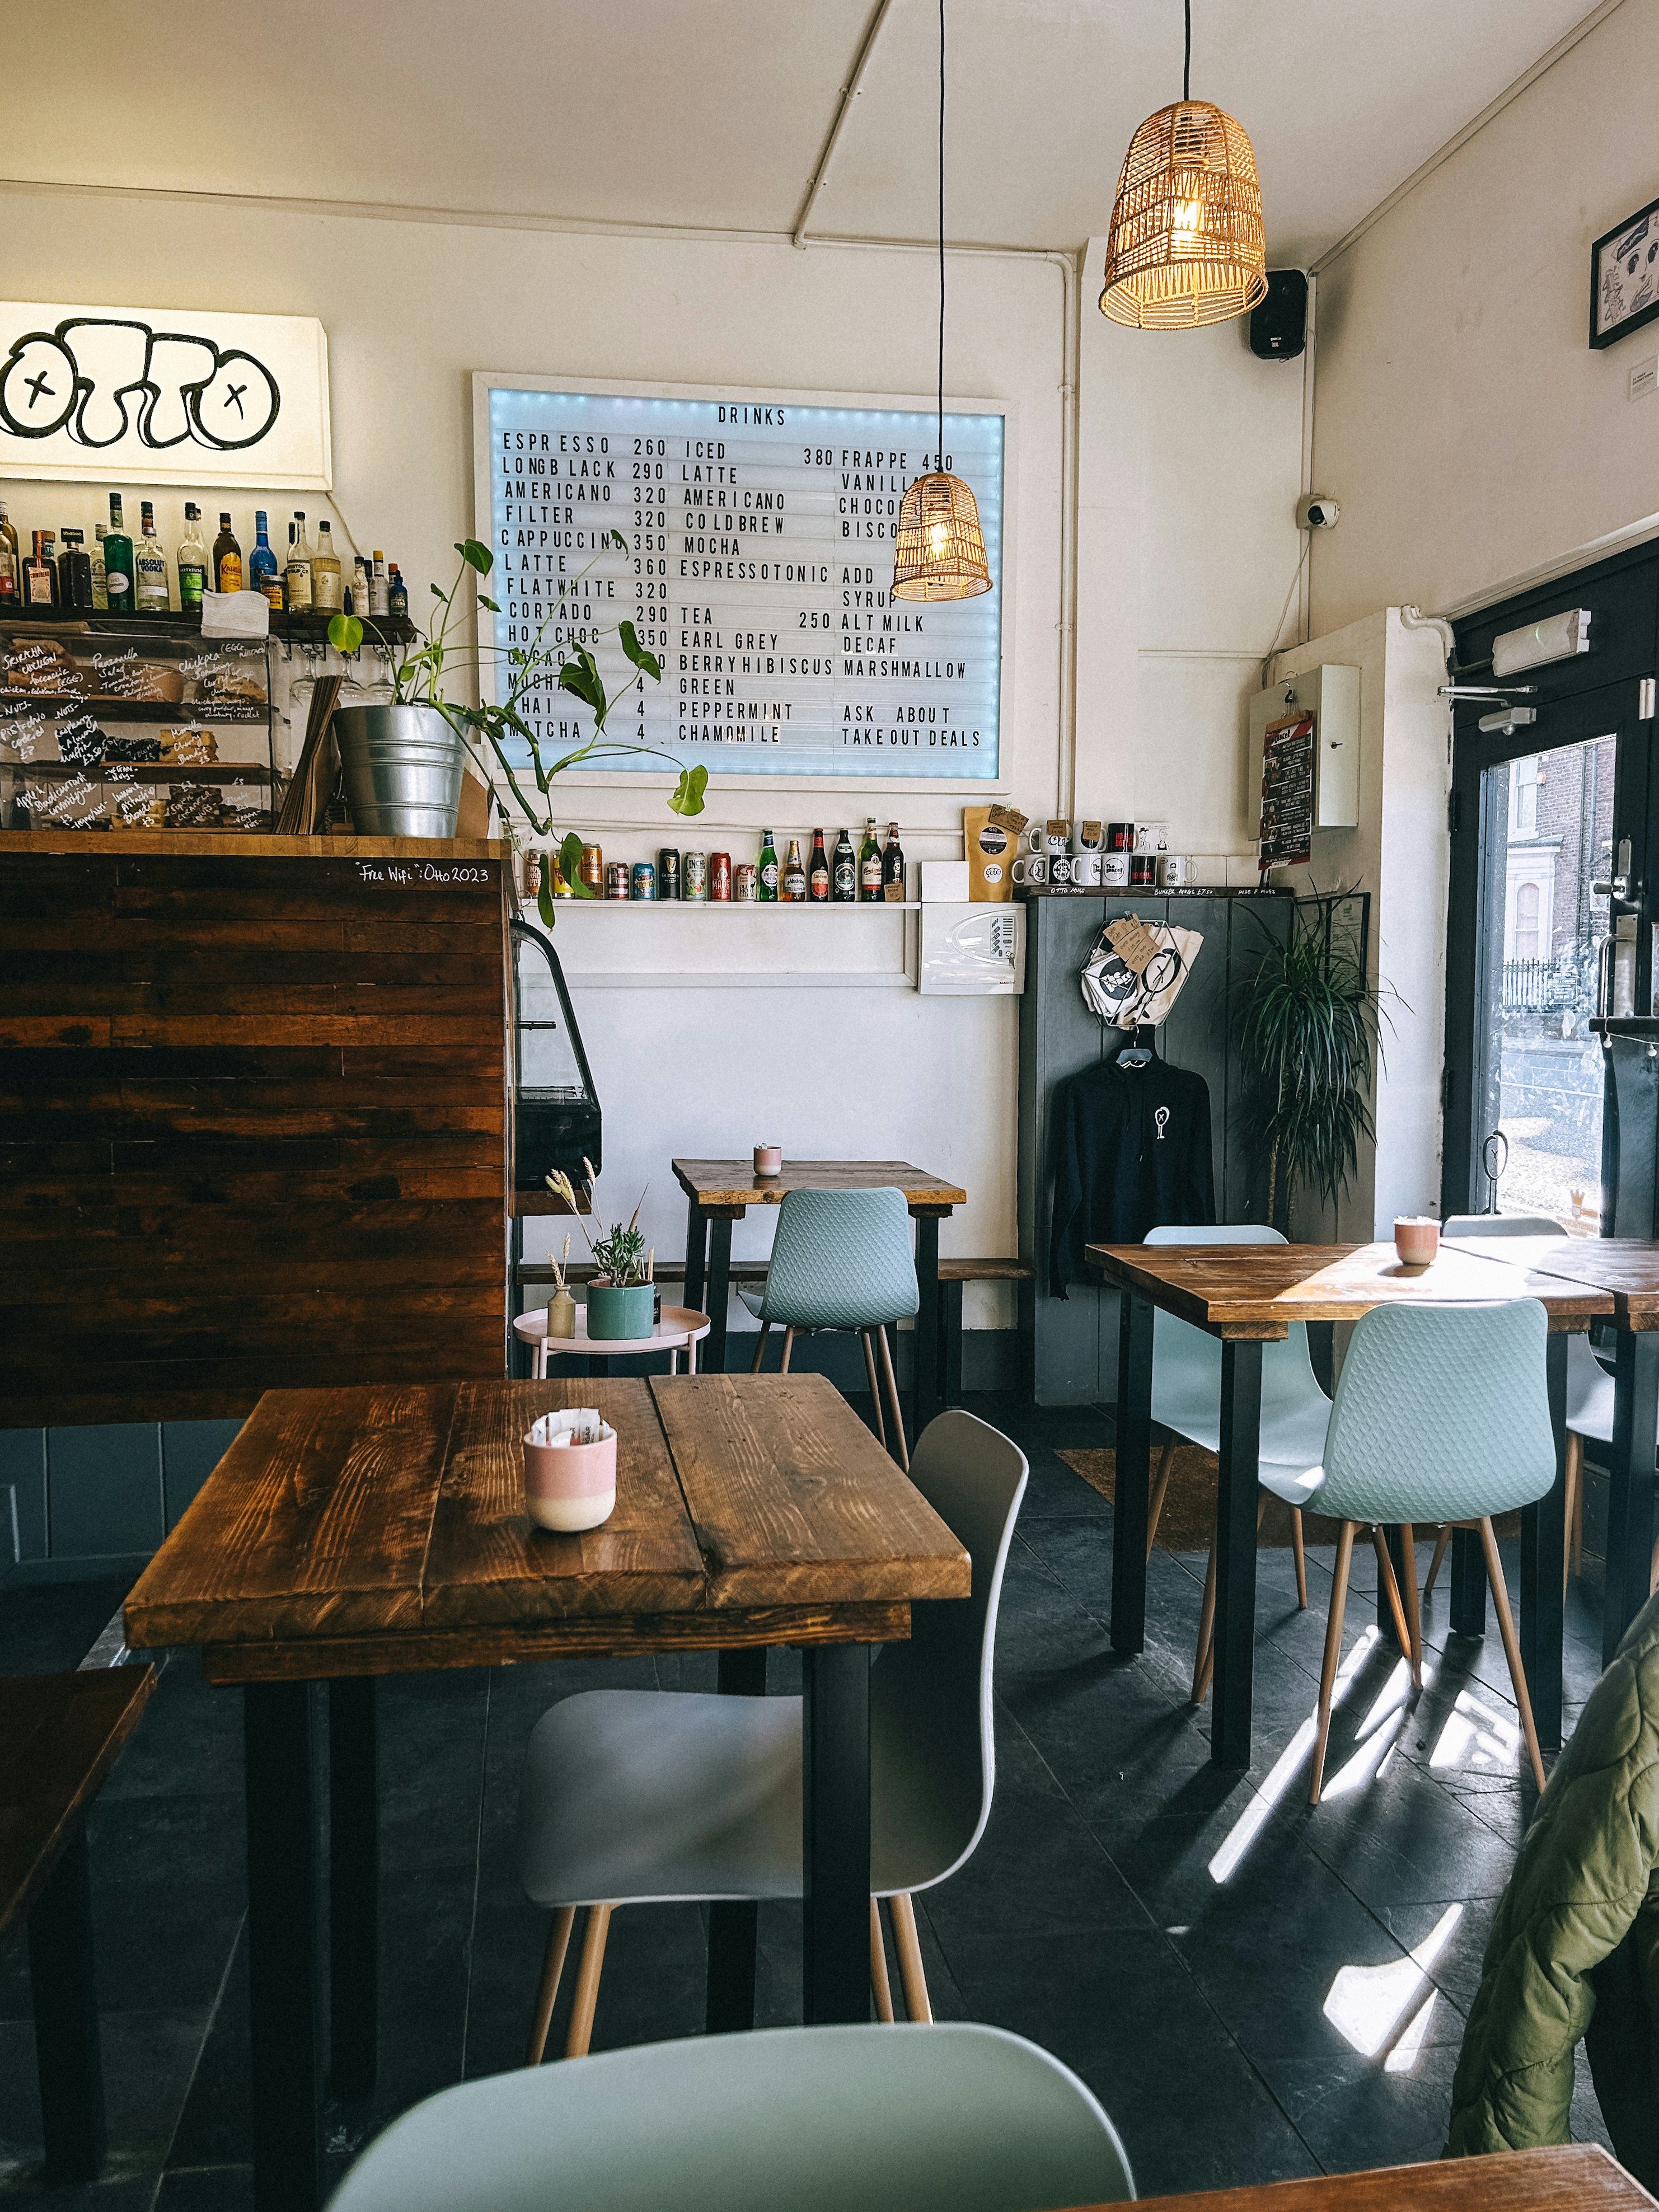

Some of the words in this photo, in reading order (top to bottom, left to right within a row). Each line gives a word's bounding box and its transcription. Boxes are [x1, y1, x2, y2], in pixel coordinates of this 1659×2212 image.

[0, 317, 280, 451] OTTO
[719, 407, 784, 425] DRINKS
[504, 433, 608, 453] ESPRESSO
[634, 439, 664, 456] 260
[687, 441, 724, 459] ICED
[804, 448, 832, 465] 380
[843, 450, 906, 468] FRAPPE
[922, 454, 952, 471] 450
[633, 463, 662, 479] 290
[683, 465, 736, 484] LATTE
[842, 474, 918, 492] VANILL
[505, 481, 610, 501] AMERICANO
[634, 487, 665, 504] 320
[684, 489, 784, 510] AMERICANO
[840, 498, 902, 515] CHOCO
[507, 505, 573, 523] FILTER
[635, 510, 664, 527] 320
[502, 529, 622, 549] CAPPUCCINO
[634, 534, 664, 551] 350
[685, 537, 739, 555] MOCHA
[139, 559, 165, 567] ABSOLUT
[140, 564, 163, 573] VODKA
[505, 554, 565, 571] LATTE
[634, 558, 665, 575] 360
[843, 568, 872, 583] ADD
[508, 578, 614, 597] FLATWHITE
[636, 582, 666, 599] 320
[843, 591, 896, 608] SYRUP
[510, 602, 591, 620] CORTADO
[637, 606, 667, 622] 290
[681, 607, 711, 624] TEA
[799, 612, 829, 628] 250
[842, 613, 873, 630] ALT
[883, 615, 922, 631] MILK
[509, 625, 543, 641] HOT
[555, 627, 598, 644] CHOC
[638, 630, 667, 646] 350
[682, 631, 723, 648] EARL
[736, 633, 777, 650] GREY
[844, 636, 896, 653] DECAF
[845, 660, 965, 678] MARSHMALLOW
[636, 677, 644, 692] 4
[681, 678, 734, 695] GREEN
[509, 697, 550, 714] HAI
[638, 701, 644, 716] 4
[680, 702, 791, 719] PEPPERMINT
[844, 706, 873, 721] ASK
[897, 707, 949, 723] ABOUT
[638, 724, 644, 739] 4
[679, 725, 778, 742] CHAMOMILE
[842, 729, 883, 744] TAKE
[891, 730, 919, 745] OUT
[930, 730, 979, 746] DEALS
